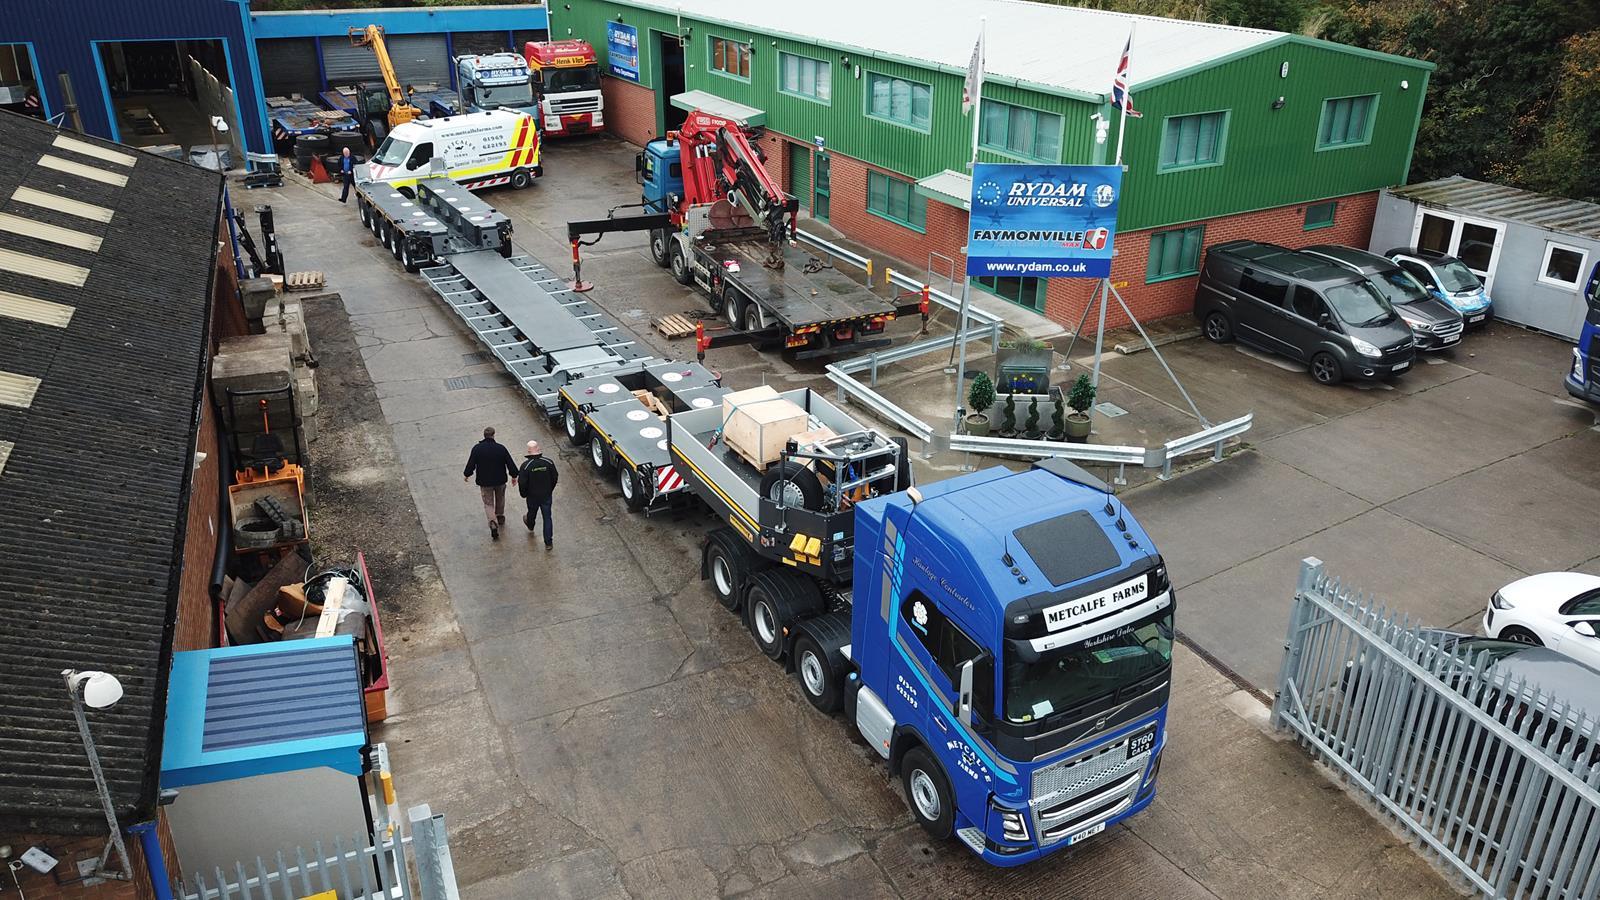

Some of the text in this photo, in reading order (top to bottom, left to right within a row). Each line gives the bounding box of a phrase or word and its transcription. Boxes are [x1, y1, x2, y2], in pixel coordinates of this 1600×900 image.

[1008, 182, 1087, 197] RYDAM
[1007, 197, 1084, 207] UNIVERSAL
[973, 230, 1083, 242] FAYMONVILLE
[986, 262, 1087, 274] www.rydam.co.uk
[1048, 582, 1145, 623] METCALFE FARMS
[1084, 625, 1135, 649] Yorkshire Dales
[1130, 732, 1154, 750] STGO
[1131, 746, 1145, 756] CAT
[946, 740, 992, 783] METCALFE
[957, 760, 979, 780] FARMS
